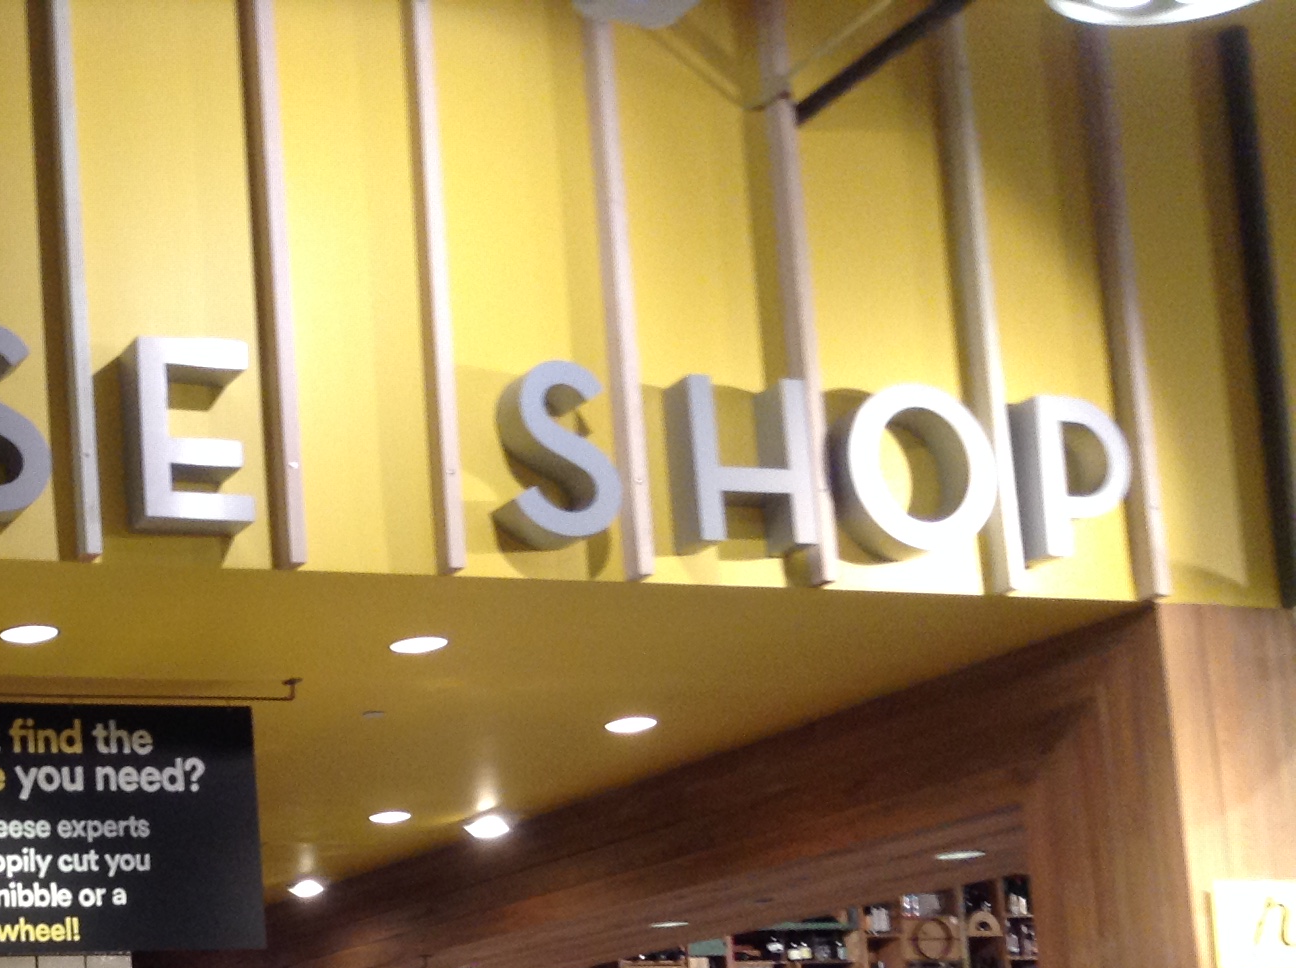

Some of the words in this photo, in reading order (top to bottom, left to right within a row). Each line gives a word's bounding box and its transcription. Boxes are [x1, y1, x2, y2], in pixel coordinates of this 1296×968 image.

[491, 359, 1133, 569] SHOP
[9, 718, 83, 754] find
[92, 719, 153, 755] the
[14, 765, 84, 800] you
[95, 757, 206, 792] need?
[57, 815, 151, 843] experts
[57, 850, 99, 873] cut
[104, 852, 152, 877] you
[78, 887, 107, 907] or
[112, 886, 128, 906] a
